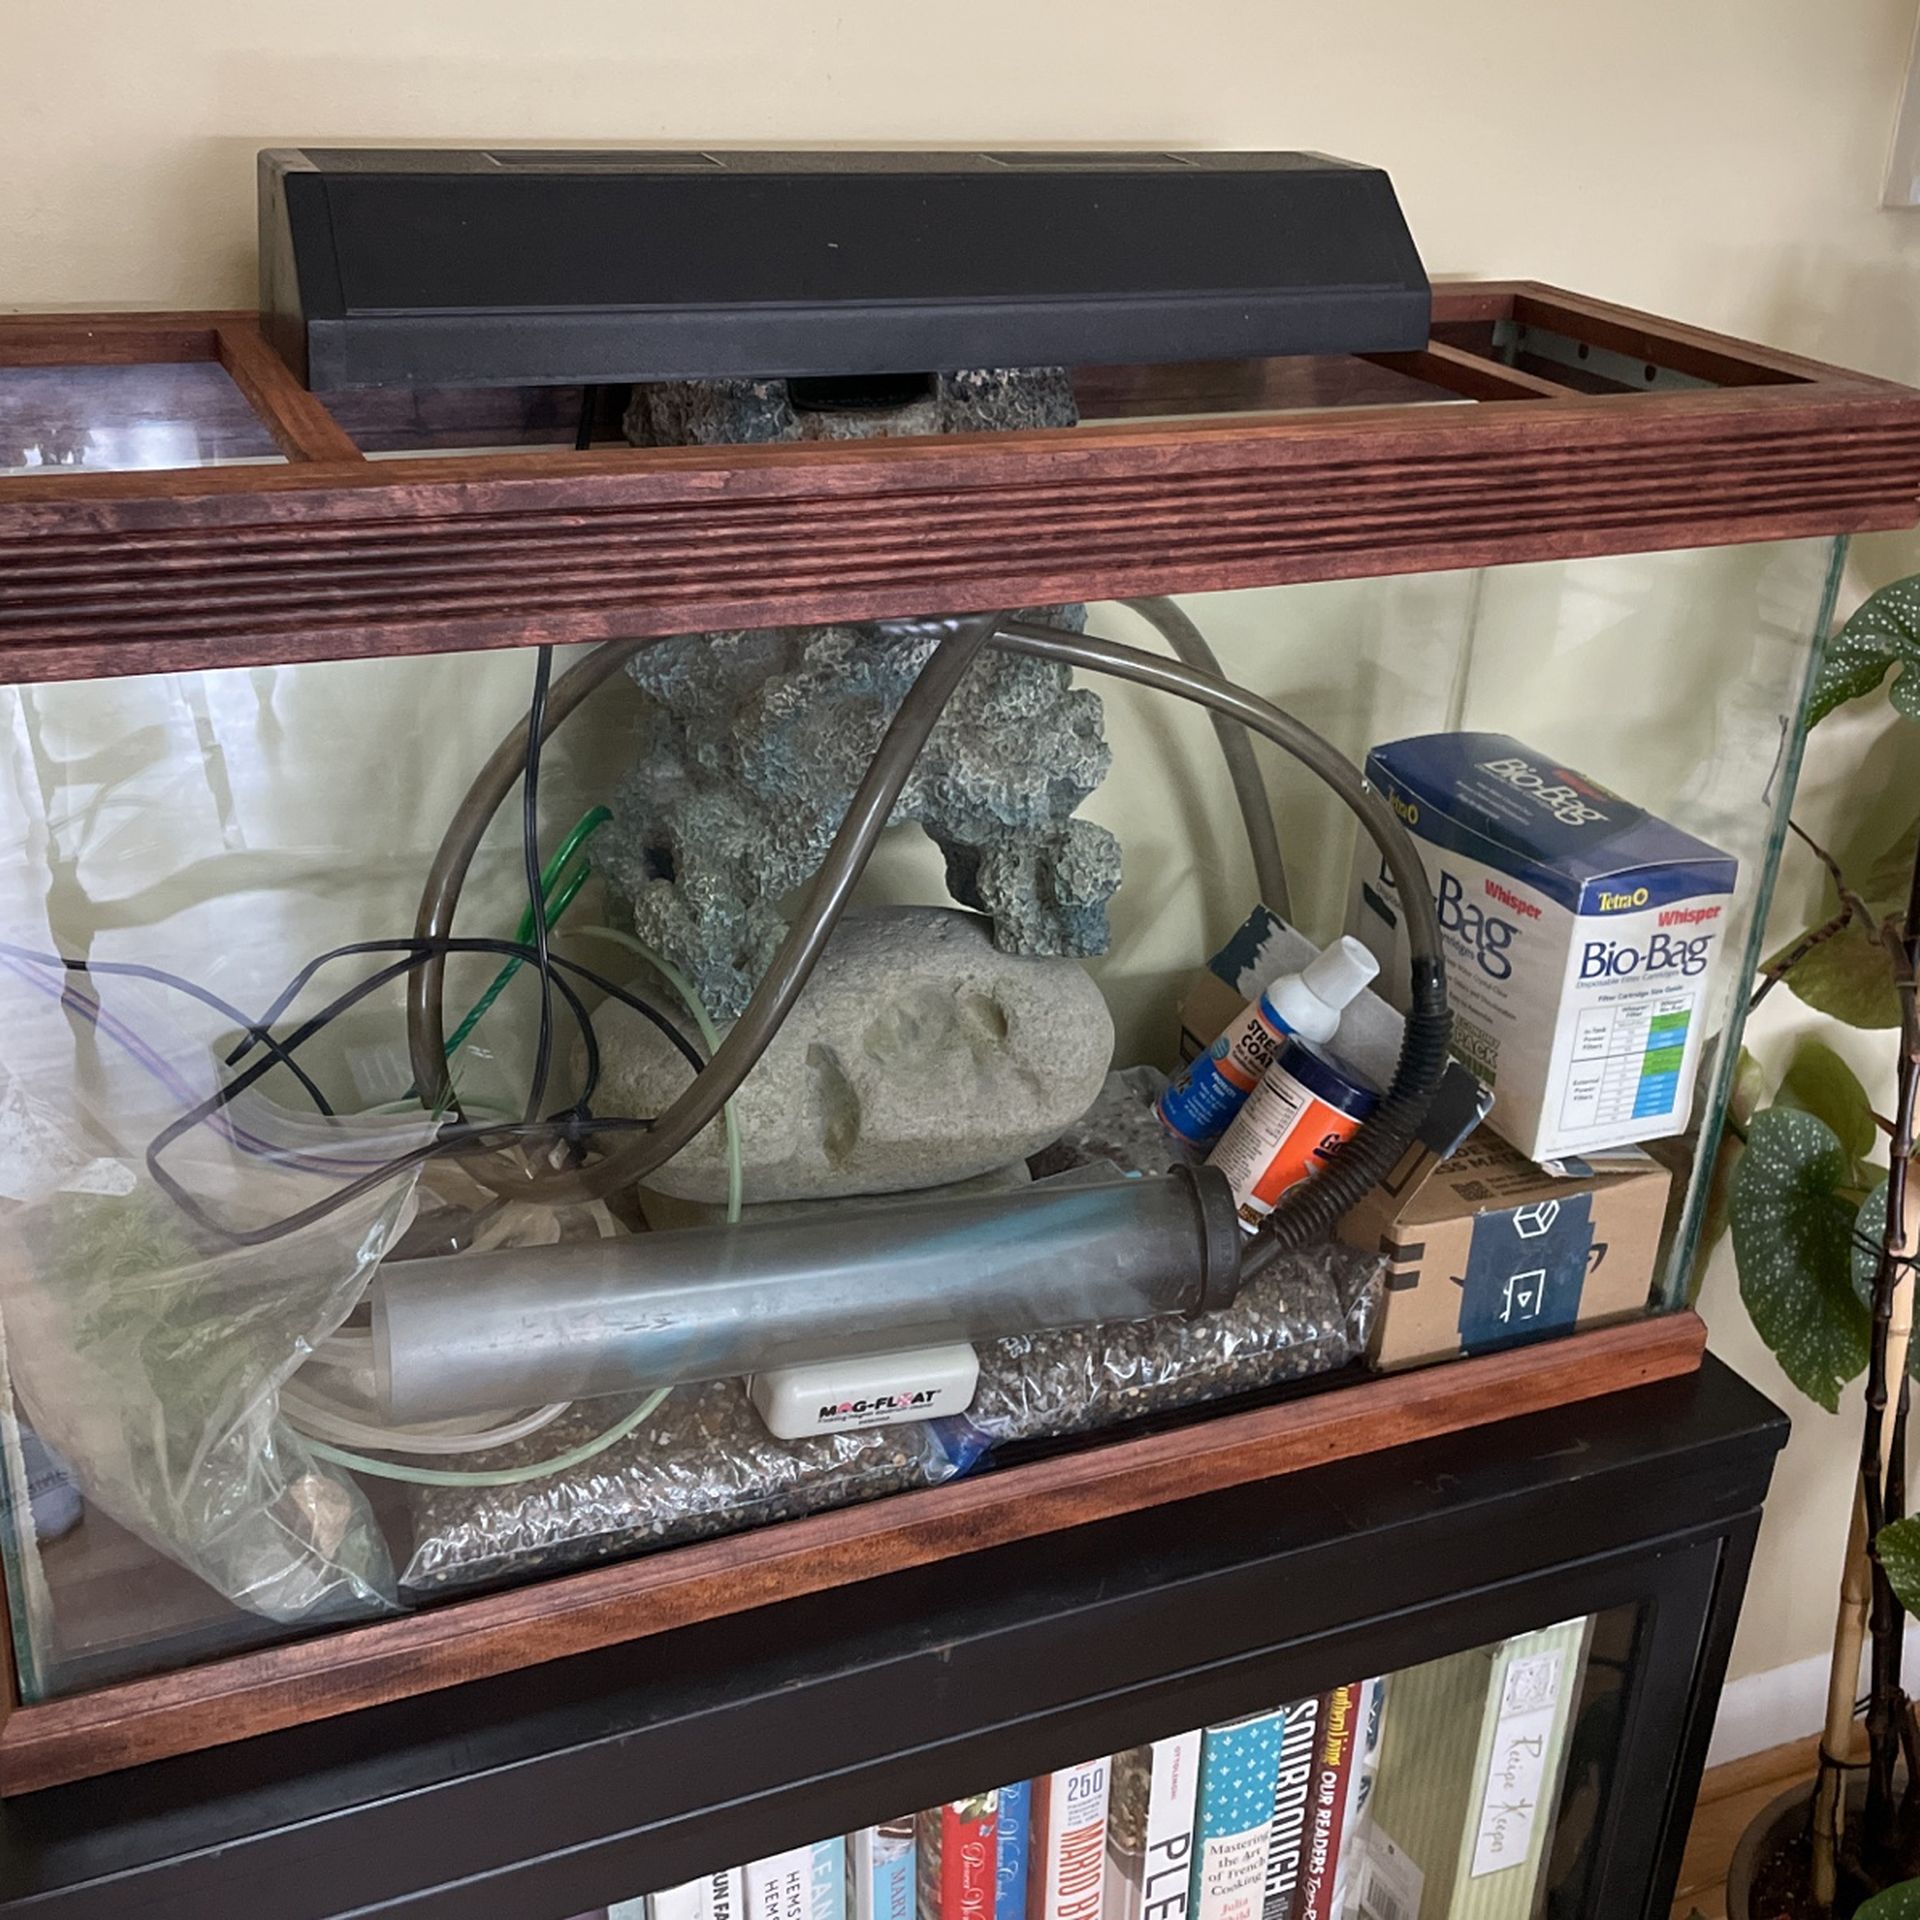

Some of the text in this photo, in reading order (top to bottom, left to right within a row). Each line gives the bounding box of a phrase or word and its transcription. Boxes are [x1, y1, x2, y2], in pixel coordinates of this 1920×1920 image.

[1483, 758, 1610, 825] Bio-Bag
[1485, 879, 1542, 920] Whisper
[1658, 906, 1722, 927] Whisper
[1579, 933, 1716, 979] Bio-Bag
[1067, 1768, 1104, 1802] 250
[1265, 1699, 1319, 1897] SOURDOUGH
[1320, 1771, 1337, 1804] OUR
[1482, 1734, 1543, 1854] Recipe Keeper
[1058, 1819, 1104, 1896] MARIO
[1210, 1830, 1270, 1856] Mastering
[1218, 1847, 1261, 1868] the Art
[1309, 1804, 1331, 1875] READERS
[1208, 1857, 1267, 1883] of French
[1210, 1871, 1263, 1897] Cooking
[890, 1867, 907, 1919] MARY
